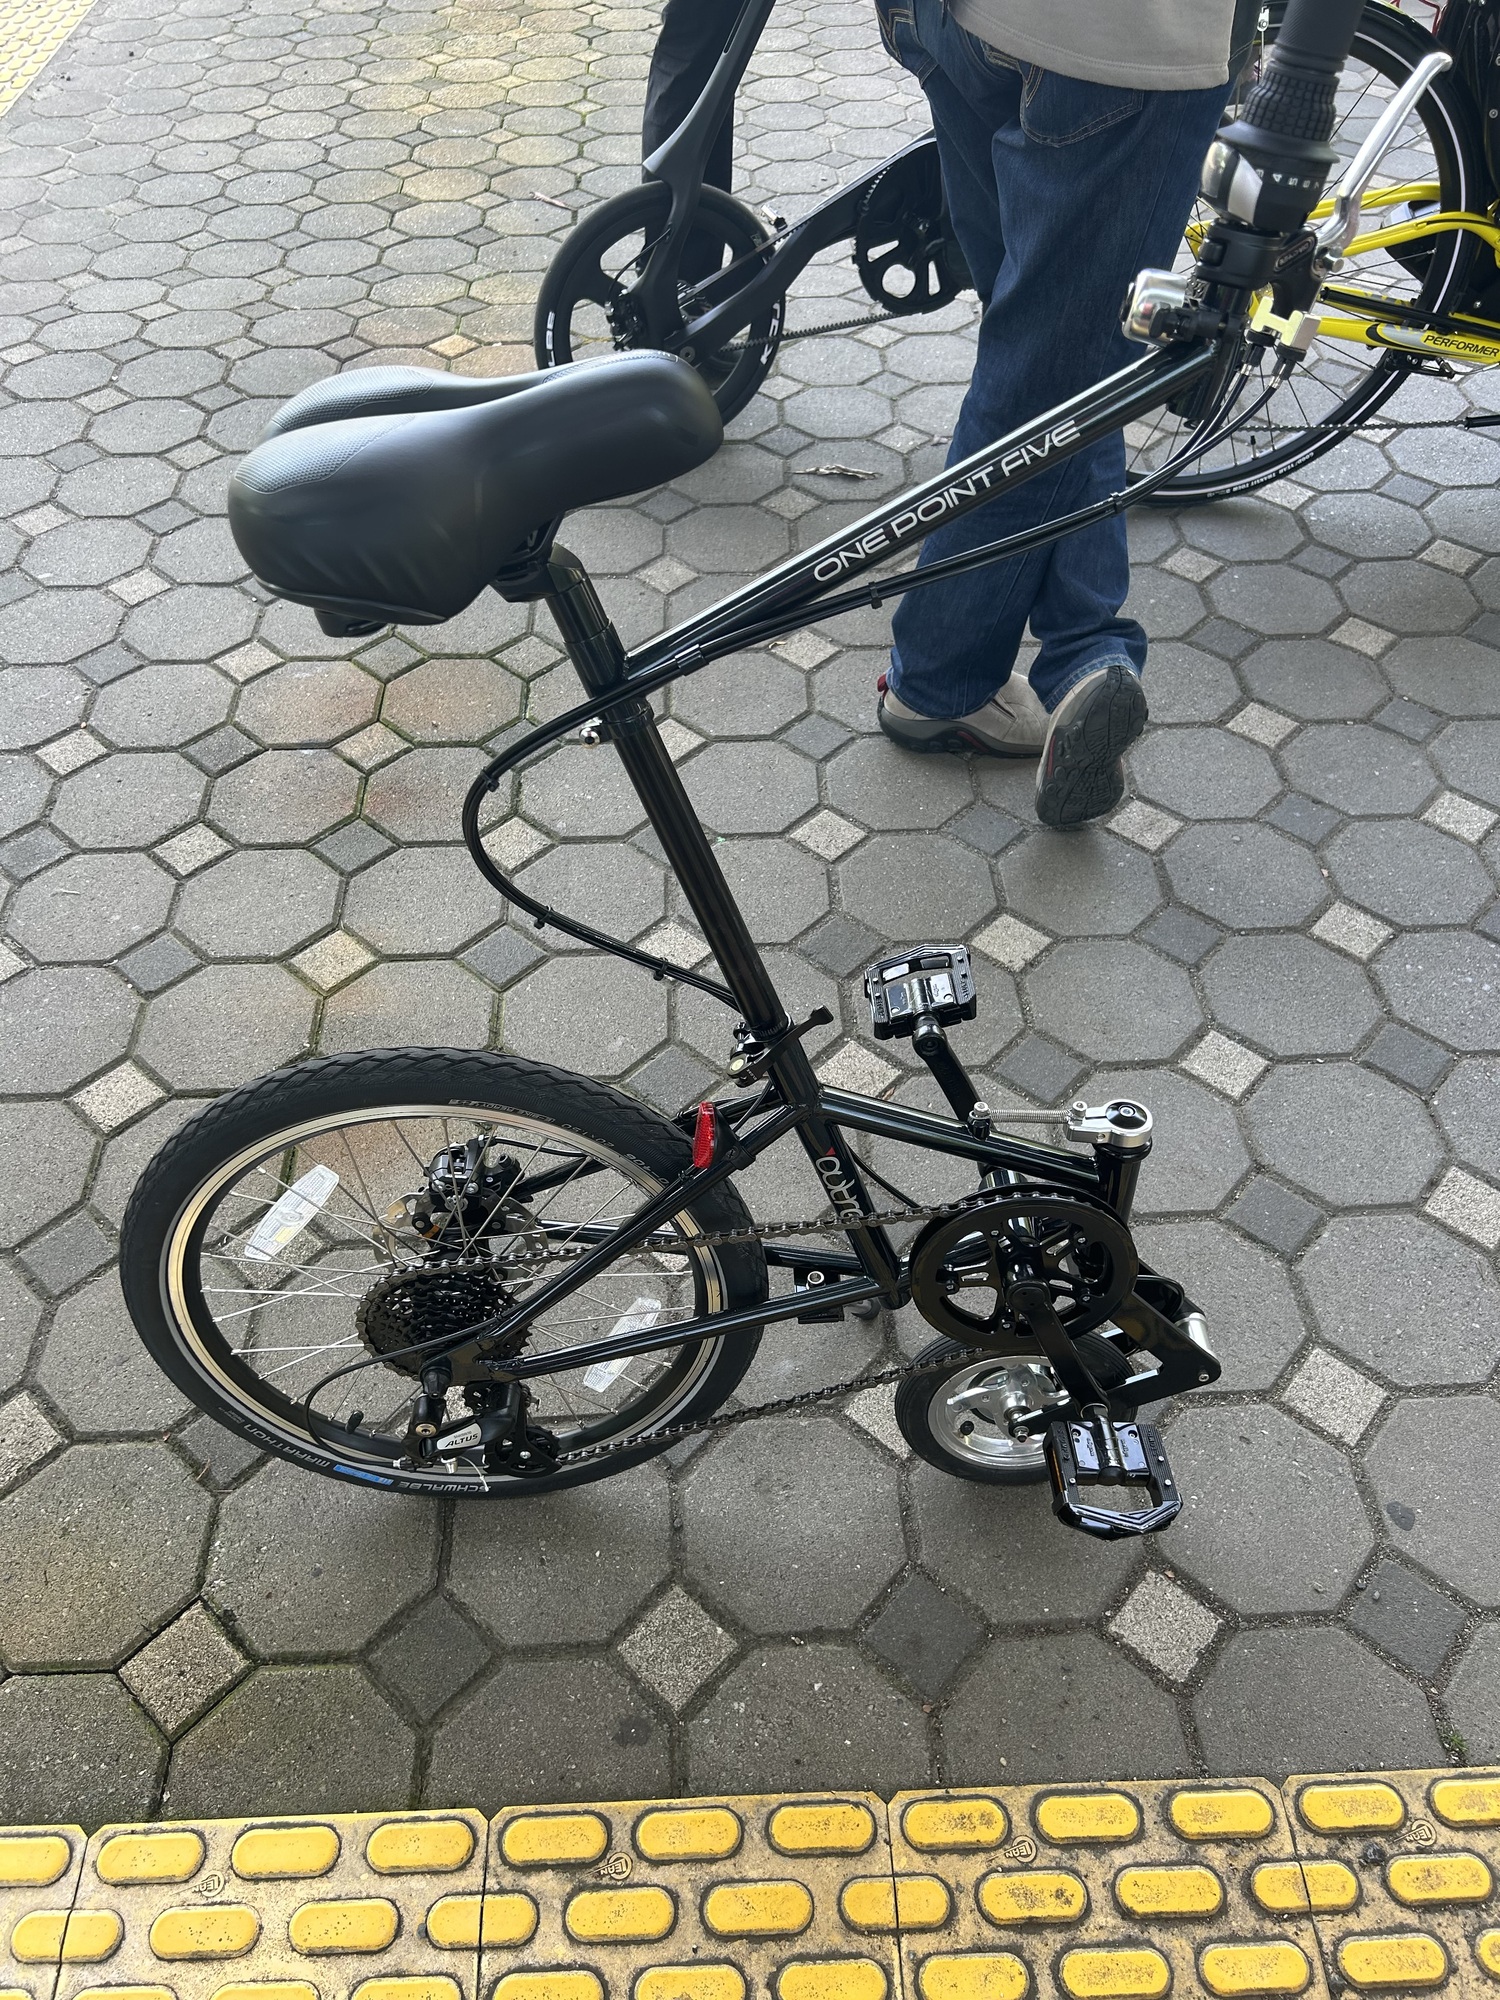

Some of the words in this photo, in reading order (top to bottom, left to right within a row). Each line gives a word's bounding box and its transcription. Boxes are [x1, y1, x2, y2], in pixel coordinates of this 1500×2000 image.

[1272, 173, 1283, 183] 4
[1288, 177, 1299, 187] 5
[1423, 334, 1500, 357] PERFORMER
[813, 527, 890, 582] ONE
[890, 466, 994, 538] POINT
[1000, 419, 1081, 477] FIVE
[624, 1152, 670, 1185] 0-406
[243, 1424, 331, 1468] MARATHON
[444, 1432, 479, 1448] ALTUS
[397, 1480, 492, 1493] SCHWALBE
